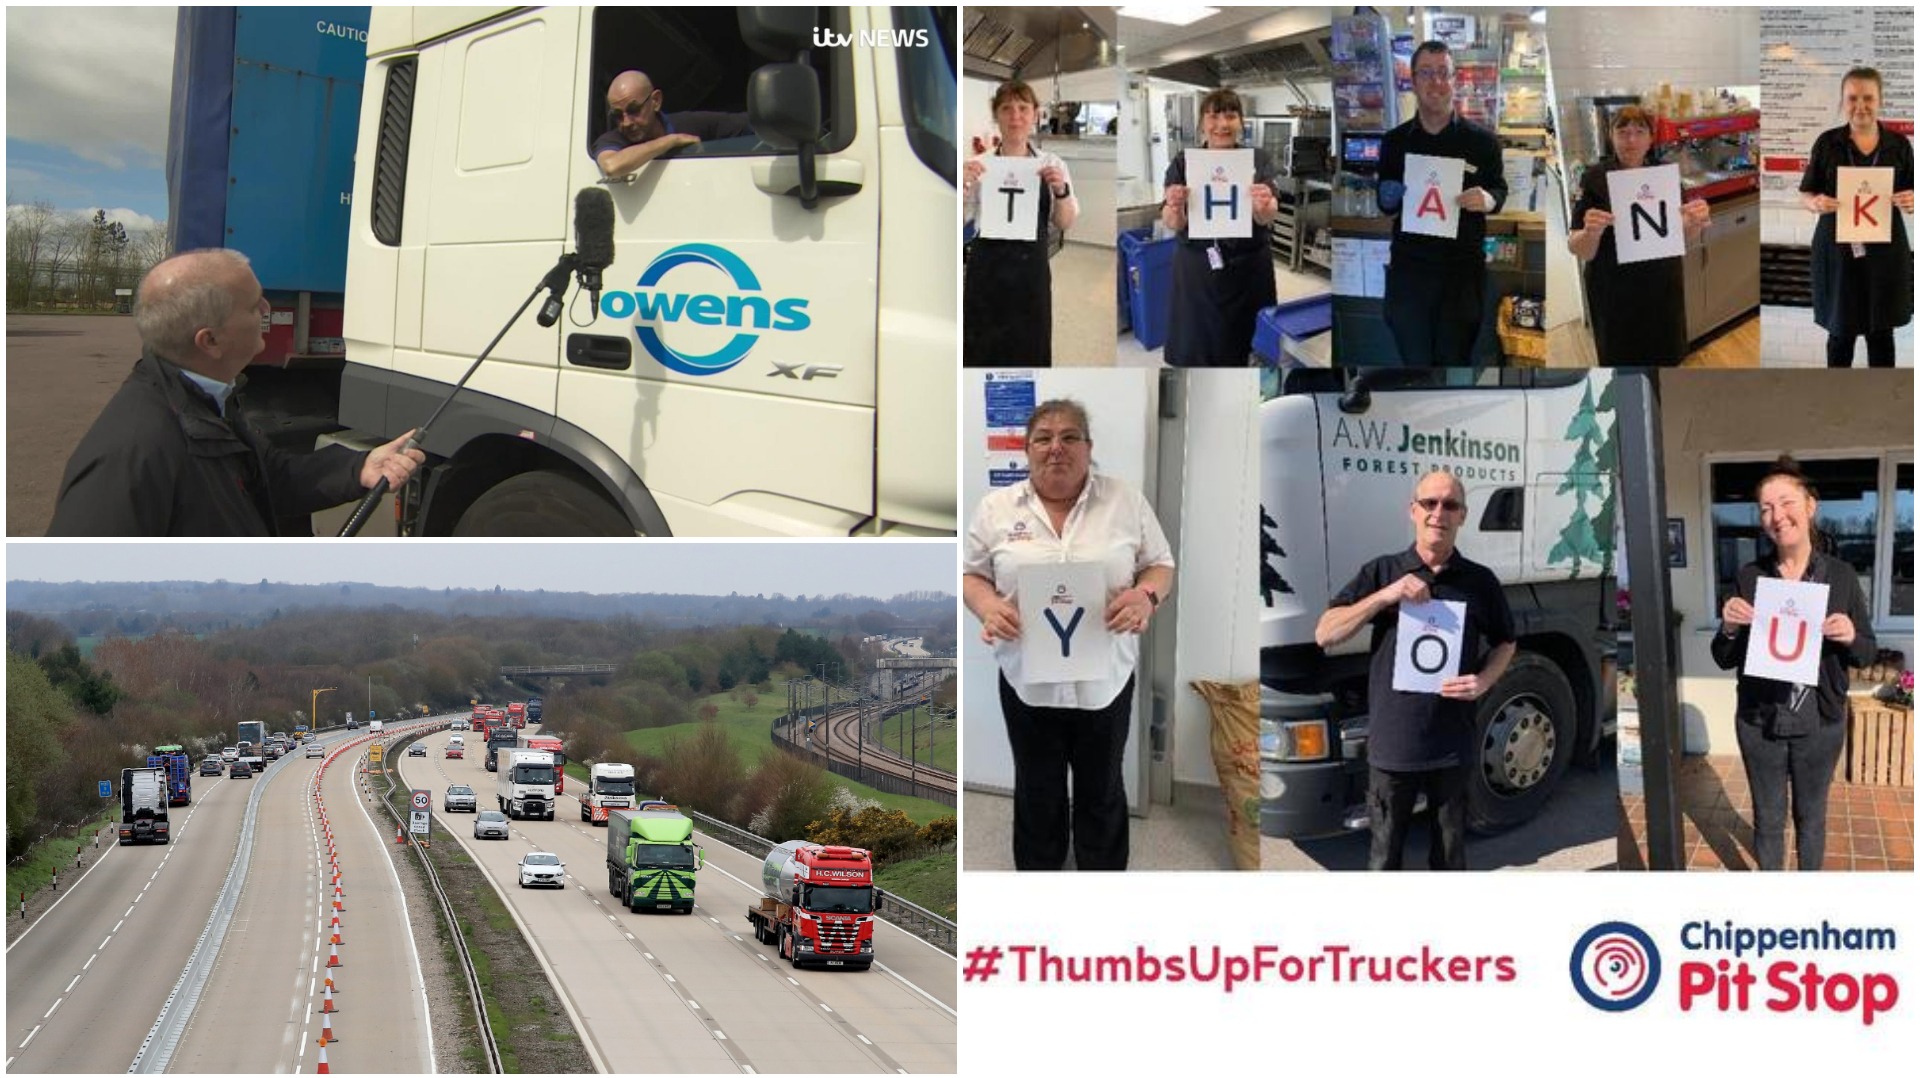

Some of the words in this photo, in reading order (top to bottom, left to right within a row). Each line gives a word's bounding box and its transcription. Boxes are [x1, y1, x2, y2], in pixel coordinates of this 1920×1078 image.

[316, 20, 368, 43] CAUTIO
[998, 187, 1025, 223] T
[1204, 184, 1238, 220] H
[1417, 187, 1446, 220] A
[1853, 195, 1880, 228] K
[1630, 200, 1669, 241] N
[600, 290, 811, 331] owens
[766, 360, 844, 381] XF
[1333, 417, 1391, 451] A.W.
[1398, 425, 1520, 463] Jenkinson
[1342, 457, 1420, 475] FOREST
[1043, 606, 1085, 658] Y
[1768, 616, 1807, 662] U
[1410, 634, 1448, 674] O
[415, 796, 427, 804] 50
